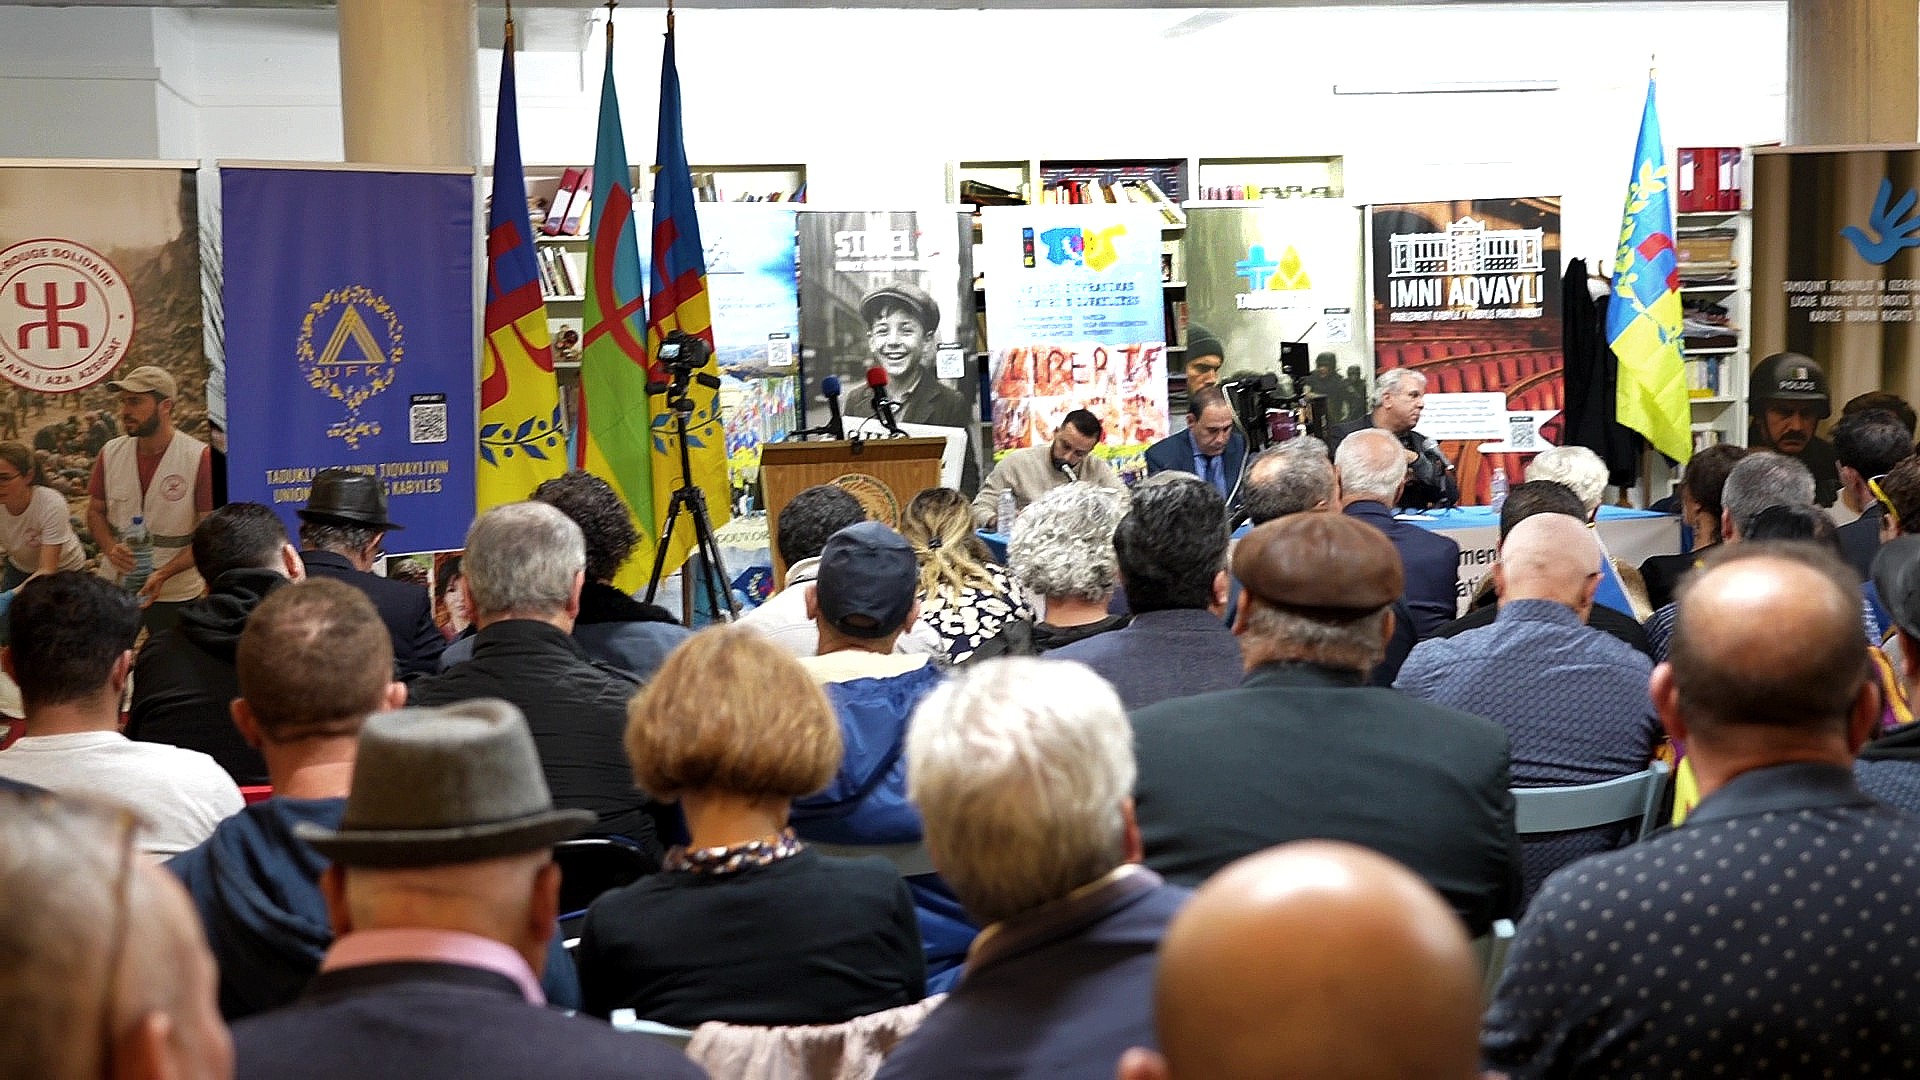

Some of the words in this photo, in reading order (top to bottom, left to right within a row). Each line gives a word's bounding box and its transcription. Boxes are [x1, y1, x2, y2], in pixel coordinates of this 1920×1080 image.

[1390, 277, 1443, 308] IMNI
[1448, 274, 1544, 310] AQVAYLI
[1779, 380, 1816, 391] POLICE
[391, 478, 443, 496] KABYLES
